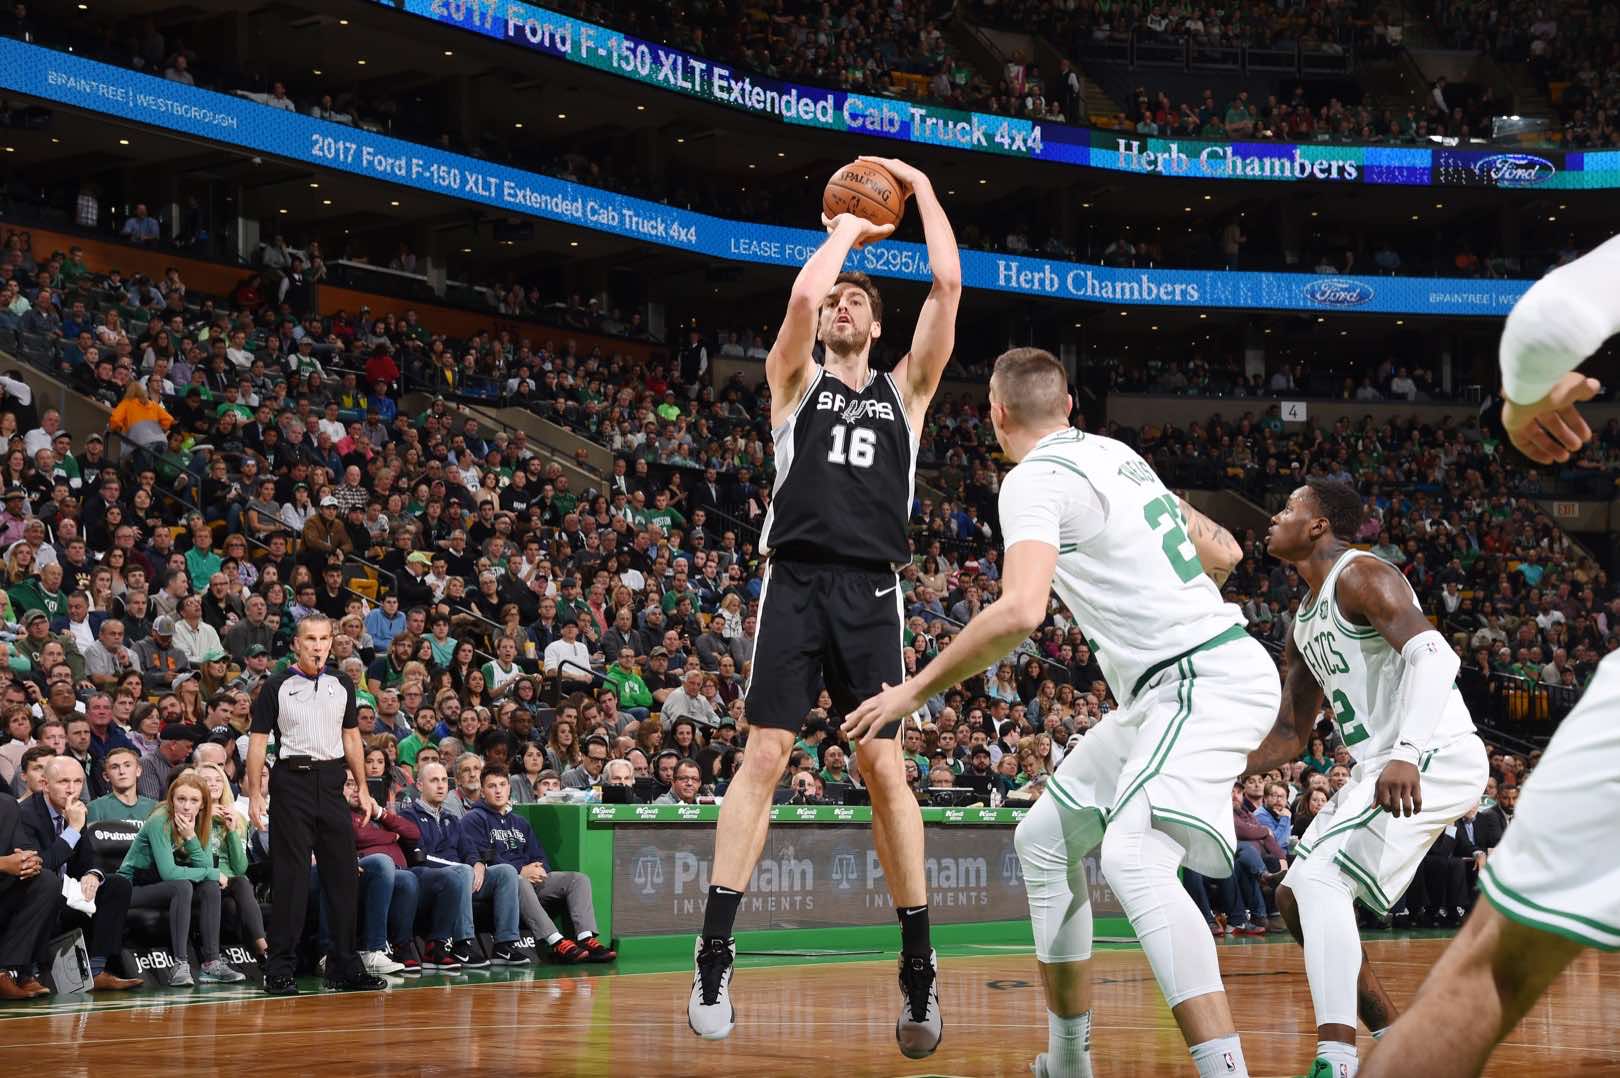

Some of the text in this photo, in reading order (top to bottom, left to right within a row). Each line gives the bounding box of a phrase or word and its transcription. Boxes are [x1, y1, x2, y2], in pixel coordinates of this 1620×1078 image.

[507, 5, 572, 53] Ford
[580, 30, 652, 78] F-150
[657, 50, 707, 92] XLT
[712, 67, 834, 124] Extended
[843, 97, 901, 133] Cab
[909, 106, 989, 149] Truck
[993, 121, 1044, 154] 4x4
[47, 70, 239, 130] BRAINTREE WESTBOROUGH
[1115, 138, 1359, 182] Herb Chambers
[1490, 158, 1540, 179] Ford
[310, 132, 697, 245] 2017 Ford F-150 XLT Extended Cab Truck 4x4
[729, 237, 782, 259] LEASE
[863, 244, 933, 275] $295/M
[996, 259, 1199, 302] Herb Chambers
[1429, 292, 1490, 305] BRAINTREE
[816, 391, 895, 424] SPURS
[1288, 404, 1297, 419] 4
[827, 424, 877, 469] 16
[673, 851, 814, 895] Puam
[865, 849, 988, 889] Pnam
[672, 895, 815, 915] INVTMENTS
[865, 891, 989, 908] INVMENTS
[133, 950, 175, 974] jetBl
